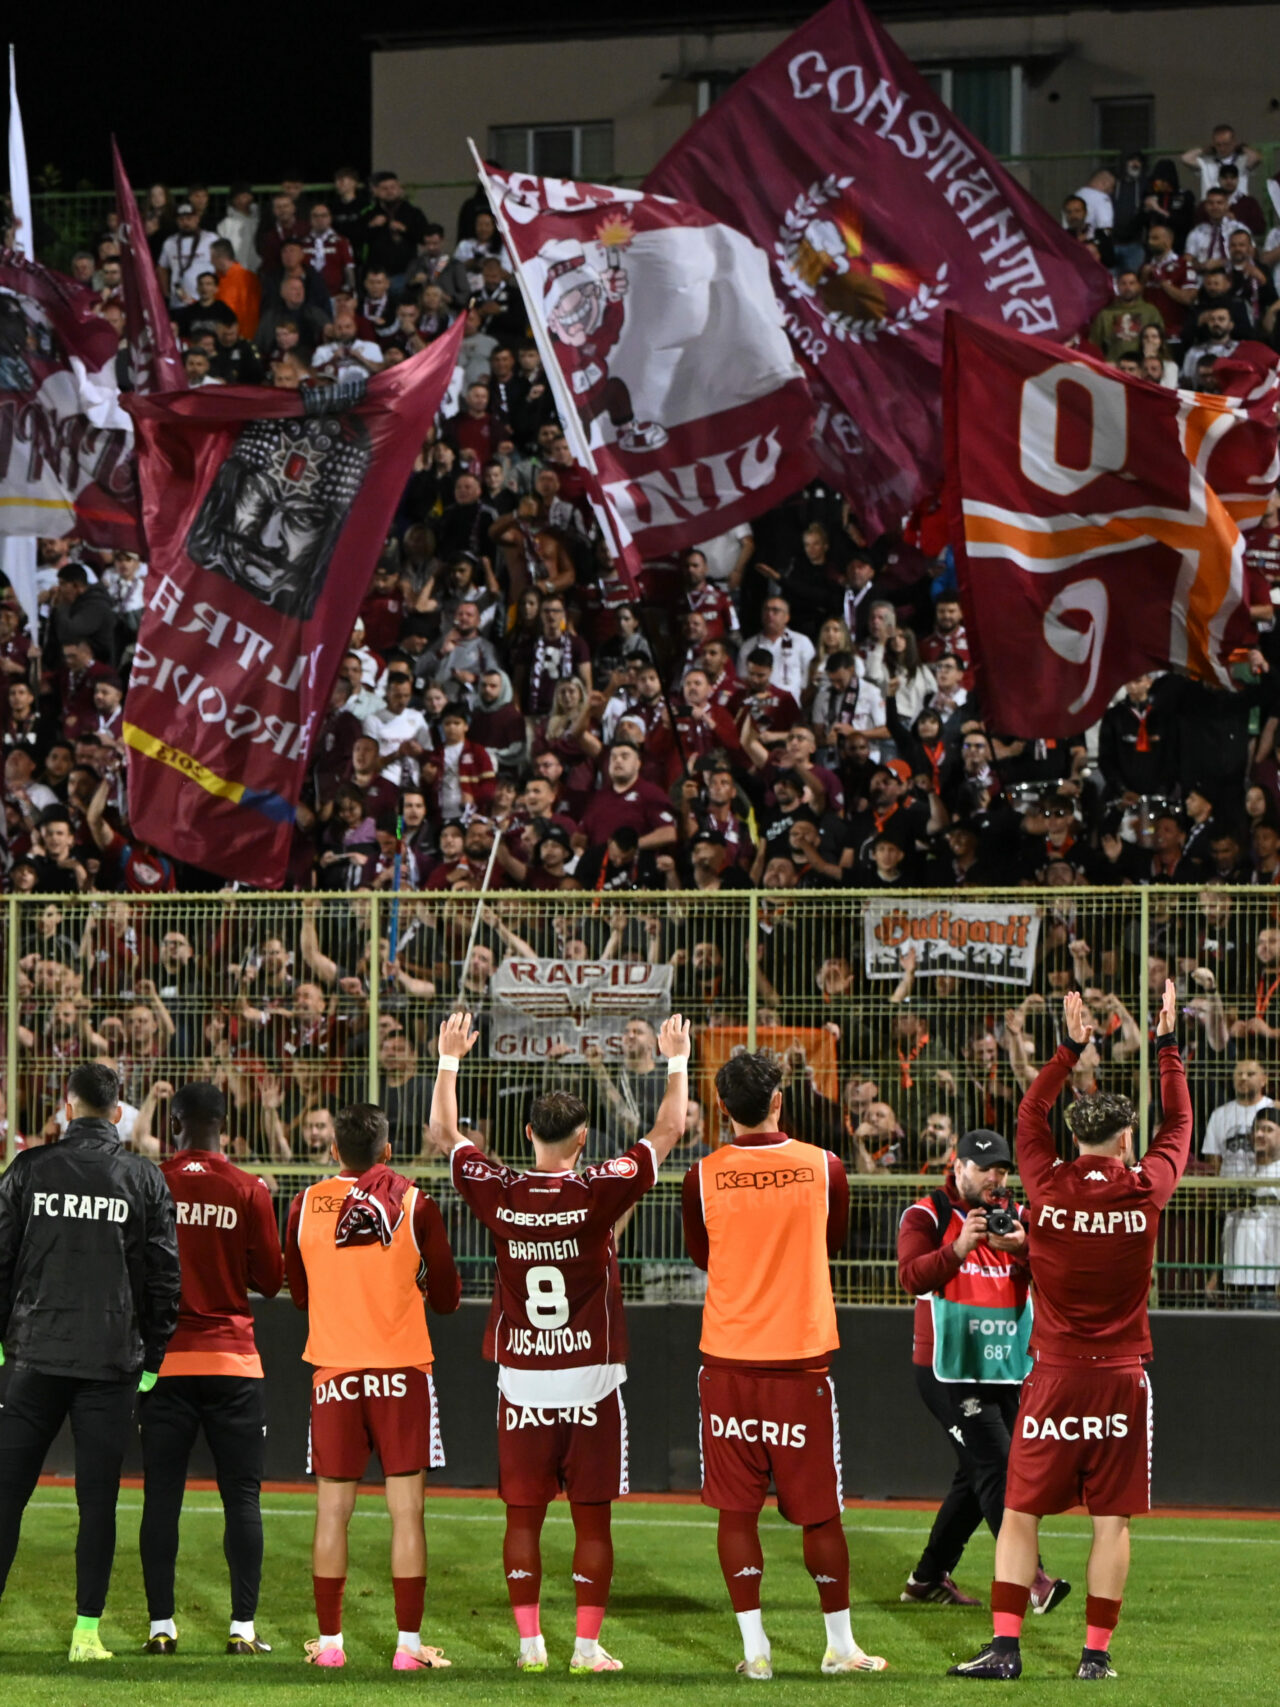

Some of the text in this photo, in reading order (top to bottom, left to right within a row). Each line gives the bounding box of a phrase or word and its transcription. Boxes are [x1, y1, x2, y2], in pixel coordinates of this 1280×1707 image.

[788, 50, 1059, 336] CONSTANTA
[510, 963, 651, 985] RAPID
[716, 1167, 815, 1190] Kappa
[33, 1192, 129, 1224] FC RAPID
[175, 1201, 238, 1230] RAPID
[1038, 1205, 1147, 1234] FC RAPID
[508, 1238, 580, 1261] GRAMENI
[525, 1265, 570, 1330] 8
[968, 1319, 1018, 1336] FOTO
[983, 1345, 1012, 1361] 687
[316, 1373, 408, 1405] DACRIS
[506, 1404, 598, 1431] DACRIS
[710, 1414, 807, 1449] DACRIS
[1022, 1413, 1128, 1441] DACRIS
